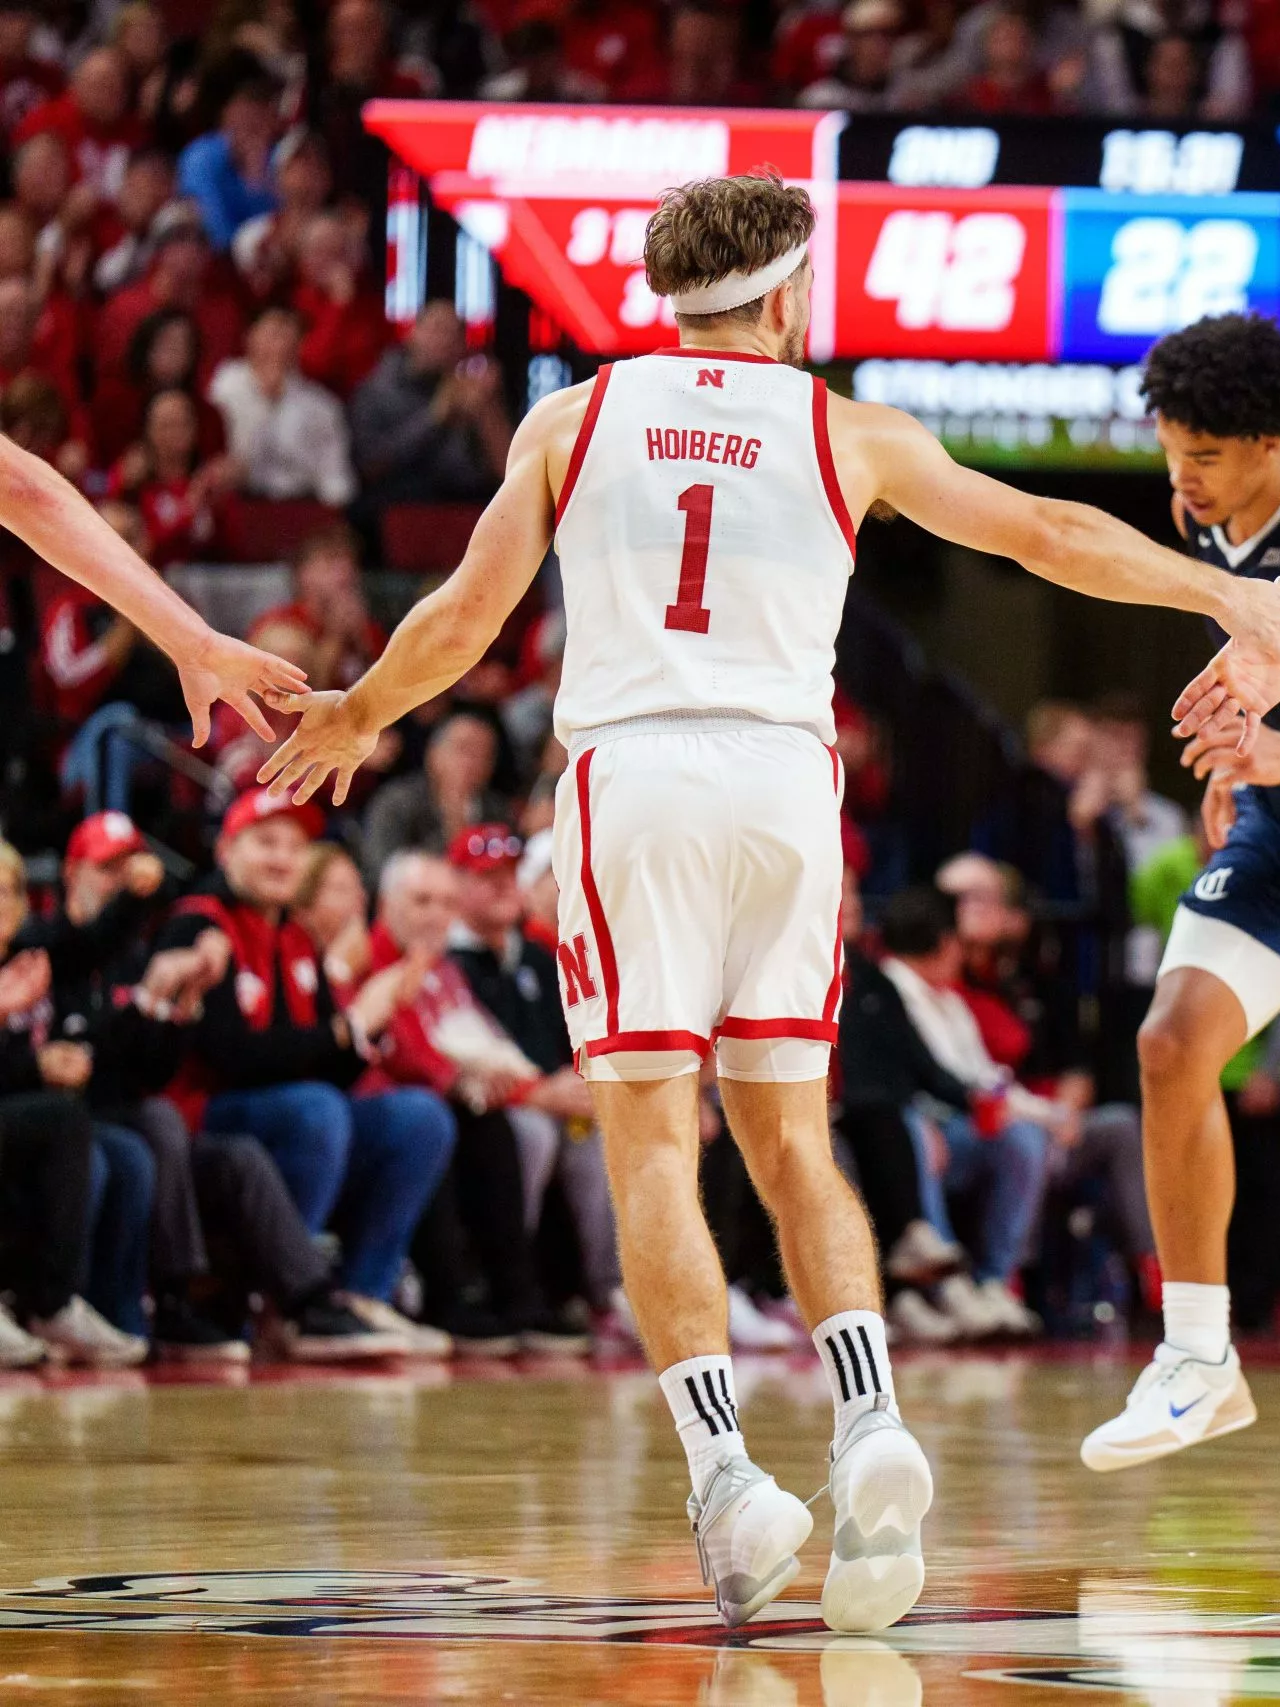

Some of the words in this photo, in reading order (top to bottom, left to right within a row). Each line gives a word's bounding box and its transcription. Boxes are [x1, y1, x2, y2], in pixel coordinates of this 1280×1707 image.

[864, 211, 1027, 331] 42
[1099, 217, 1259, 333] 22
[696, 368, 725, 389] N
[646, 427, 762, 470] HOIBERG
[664, 483, 714, 634] 1
[556, 931, 599, 1009] N
